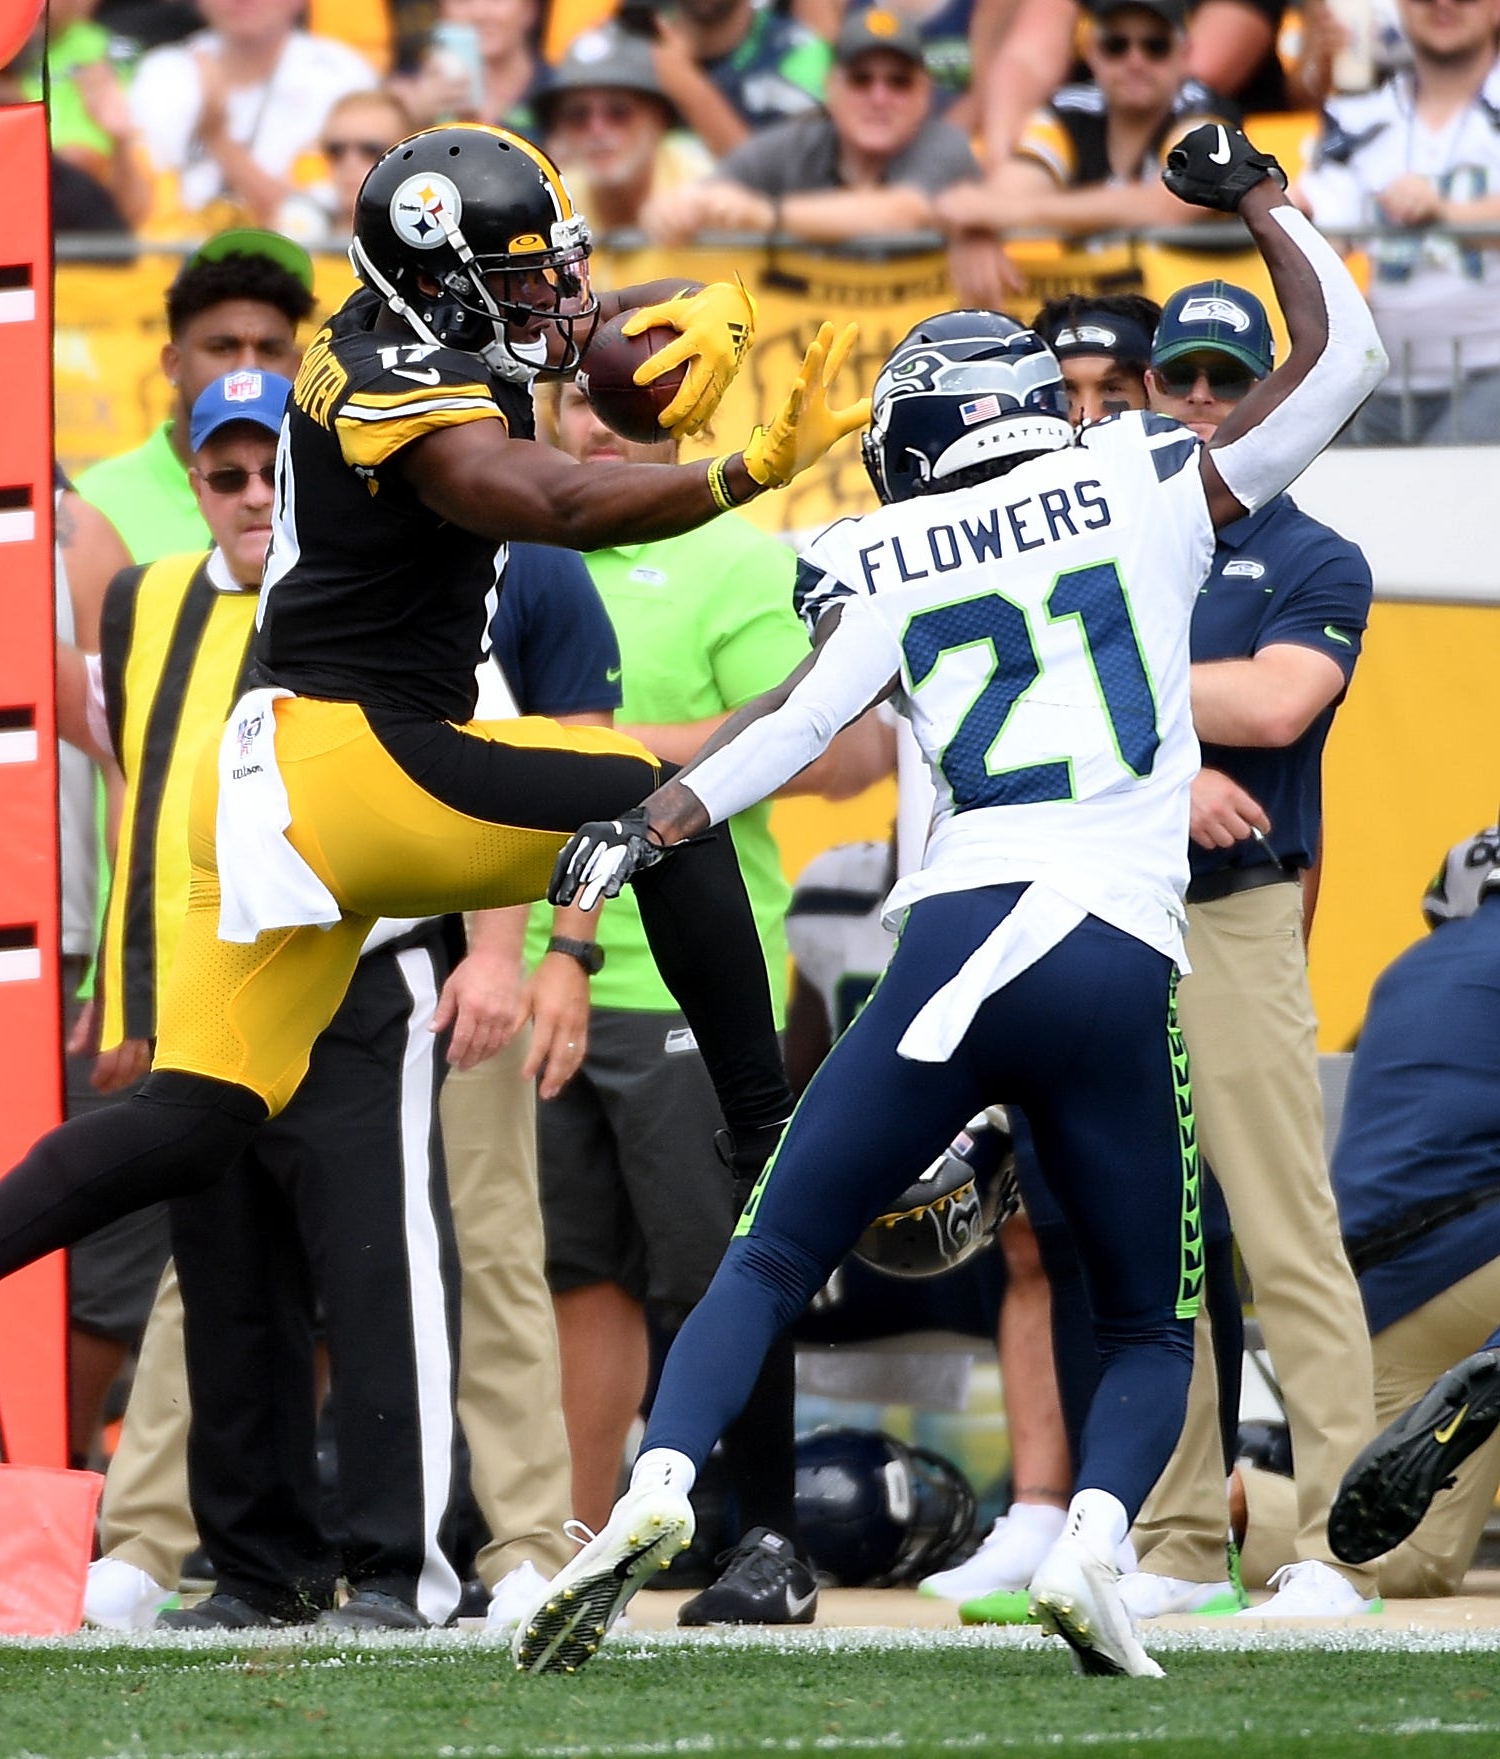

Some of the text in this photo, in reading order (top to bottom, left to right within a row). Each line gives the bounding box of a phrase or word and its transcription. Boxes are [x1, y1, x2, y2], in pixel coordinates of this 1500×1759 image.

[229, 382, 257, 397] NFL
[859, 479, 1112, 596] FLOWERS
[898, 556, 1163, 818] 21
